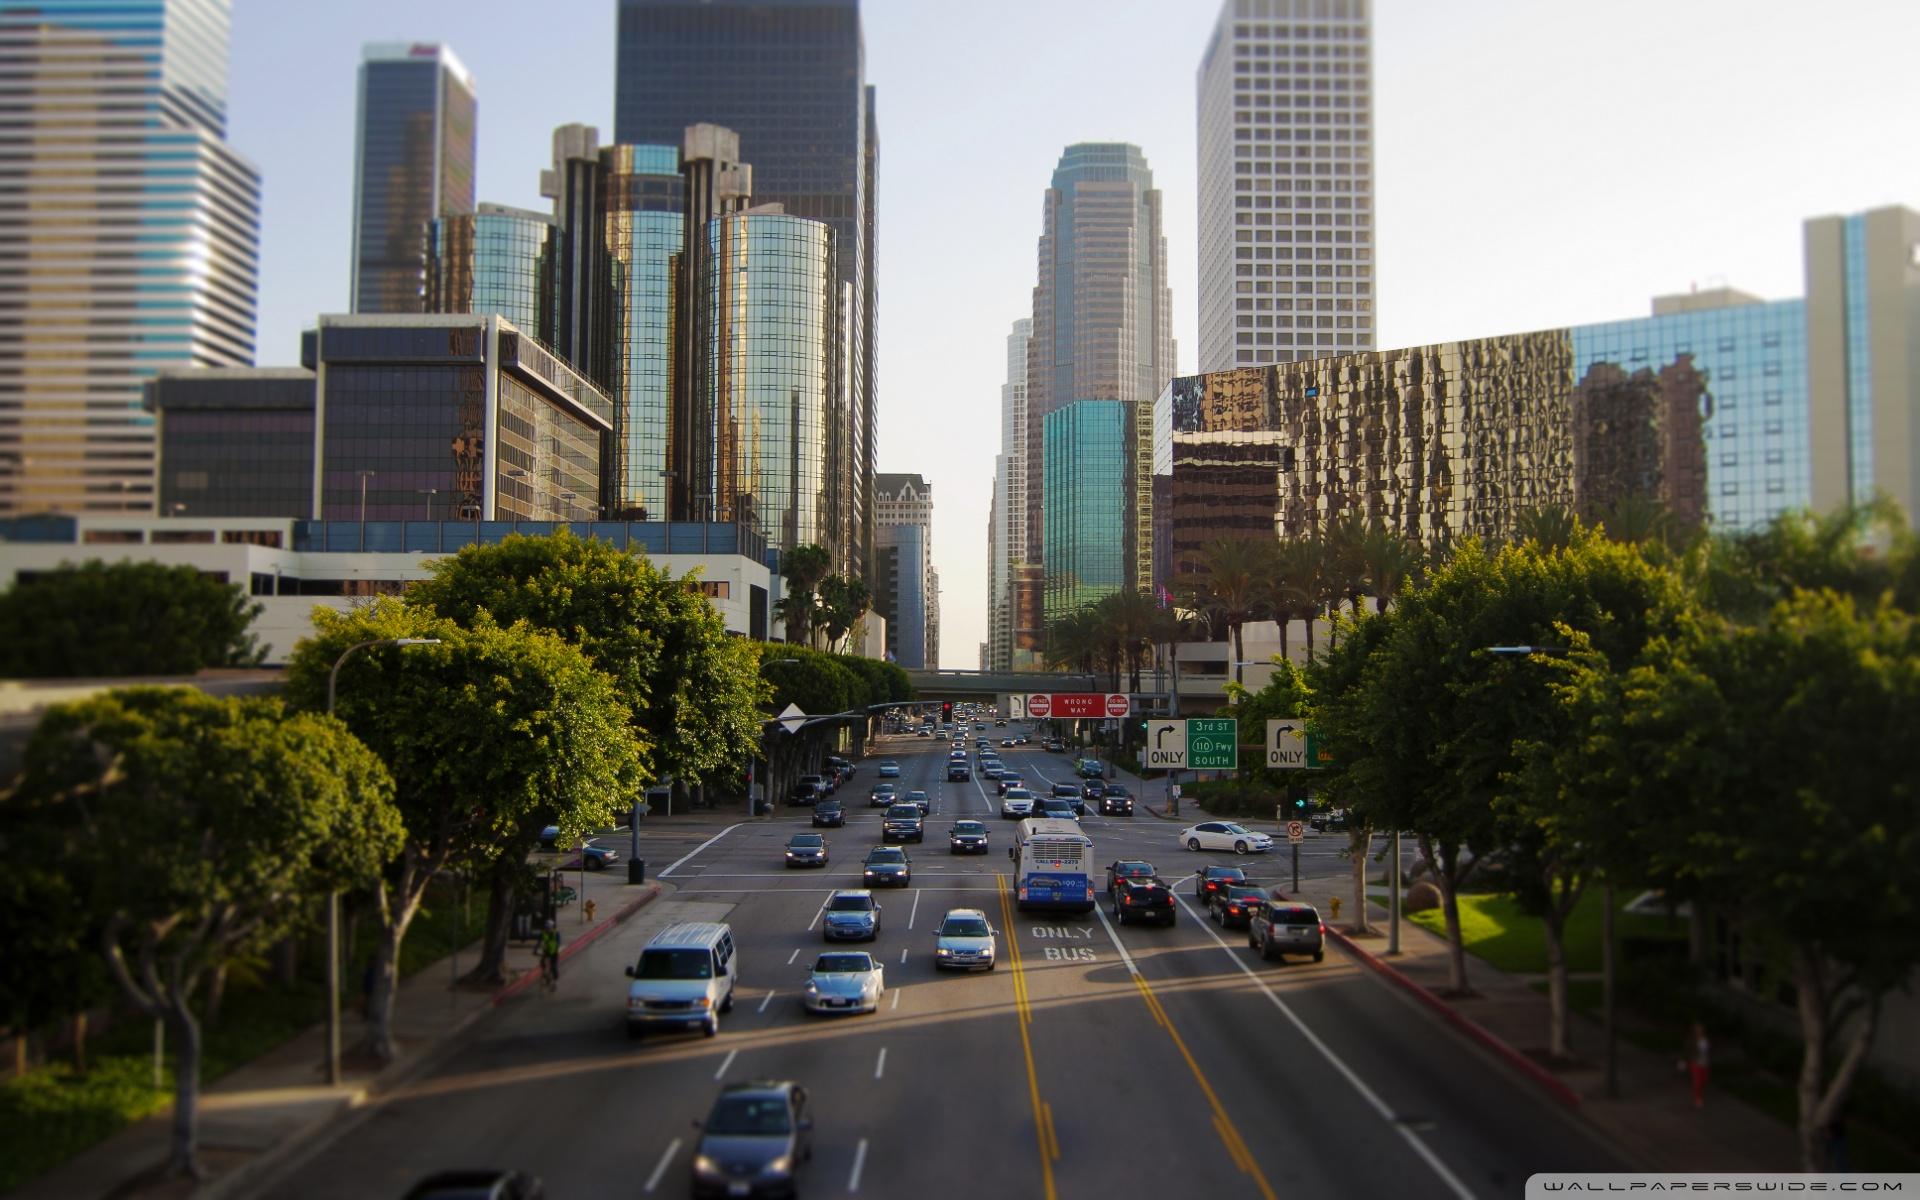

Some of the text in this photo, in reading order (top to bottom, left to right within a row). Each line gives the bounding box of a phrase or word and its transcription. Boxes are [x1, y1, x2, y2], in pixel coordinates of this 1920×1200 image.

[1196, 722, 1229, 732] 3rd ST
[1196, 742, 1232, 752] 110 Fwy
[1151, 751, 1184, 764] ONLY
[1195, 756, 1229, 764] SOUTH
[1270, 751, 1303, 764] ONLY
[1032, 926, 1094, 938] ONLY
[1044, 948, 1096, 960] BUS
